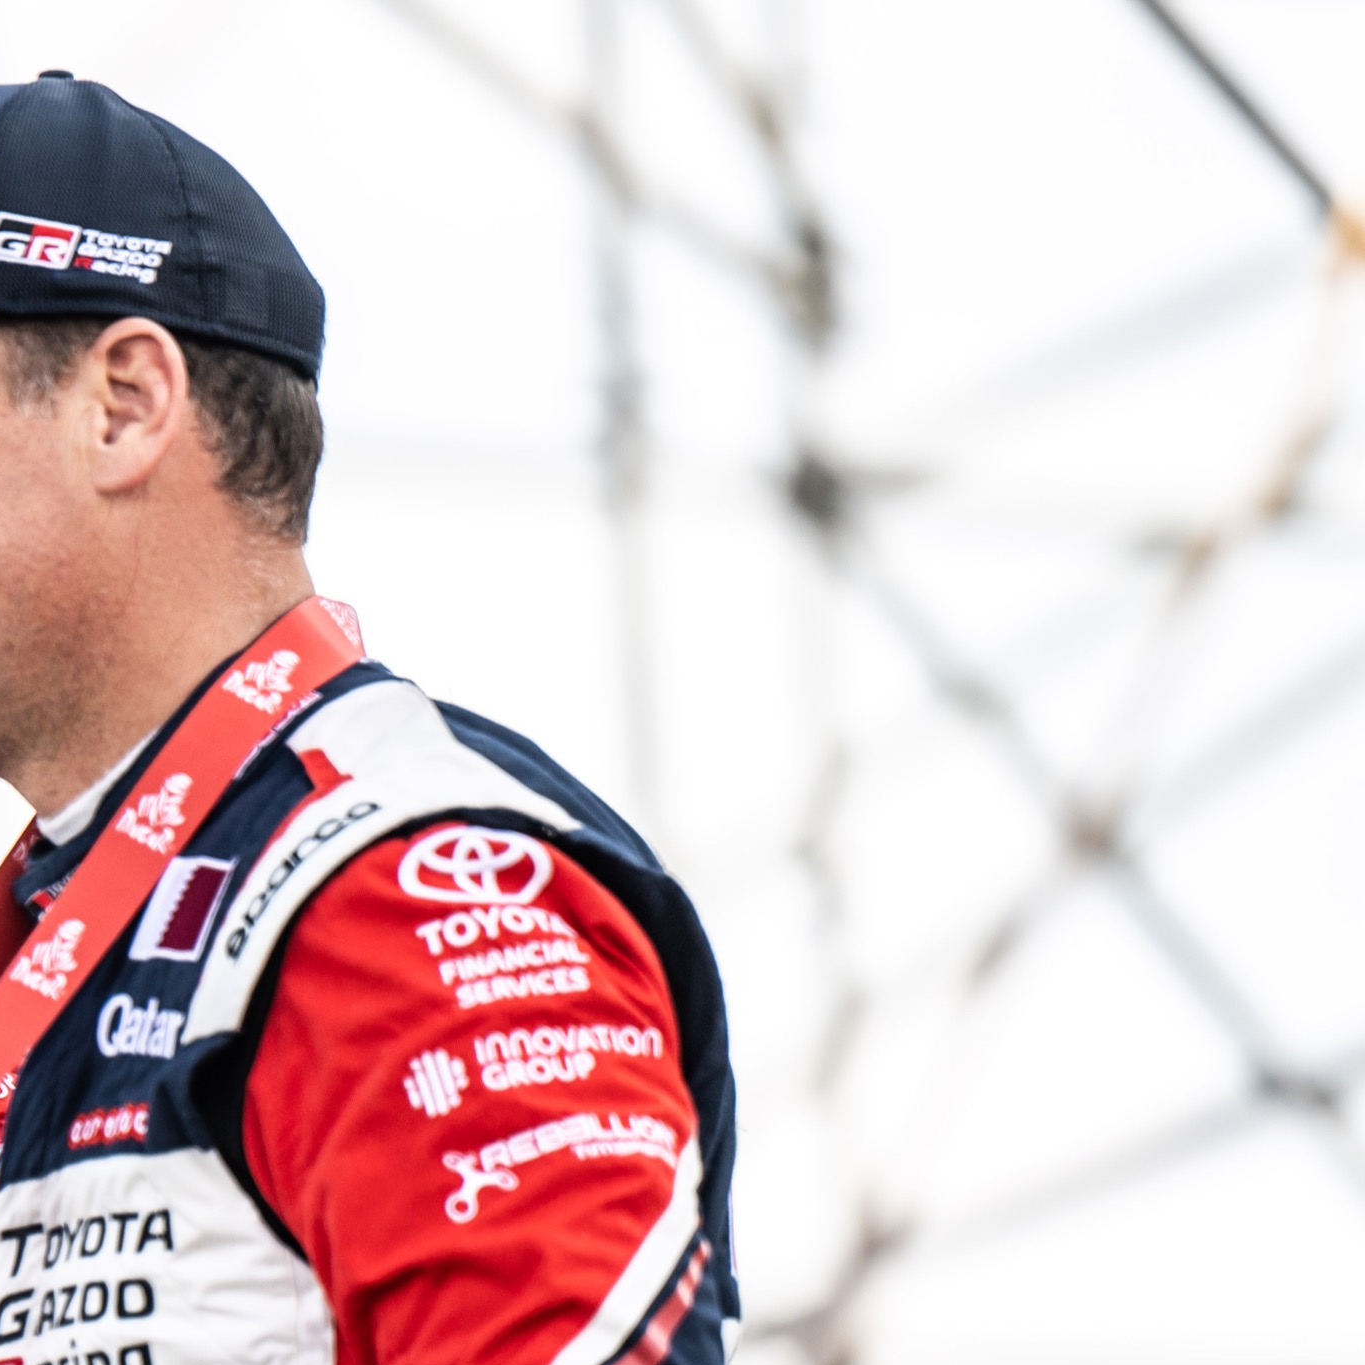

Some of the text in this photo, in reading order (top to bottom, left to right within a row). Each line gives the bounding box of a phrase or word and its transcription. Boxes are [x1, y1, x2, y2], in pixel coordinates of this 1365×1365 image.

[82, 228, 174, 255] TOYOTA
[415, 904, 579, 956] TOYOTA
[438, 938, 592, 986] FINANCIAL
[455, 965, 592, 1010] SERVICES
[95, 992, 186, 1060] Qatar
[474, 1022, 664, 1066] INNOVATION
[481, 1049, 596, 1091] GROUP
[0, 1208, 174, 1279] TOYOTA
